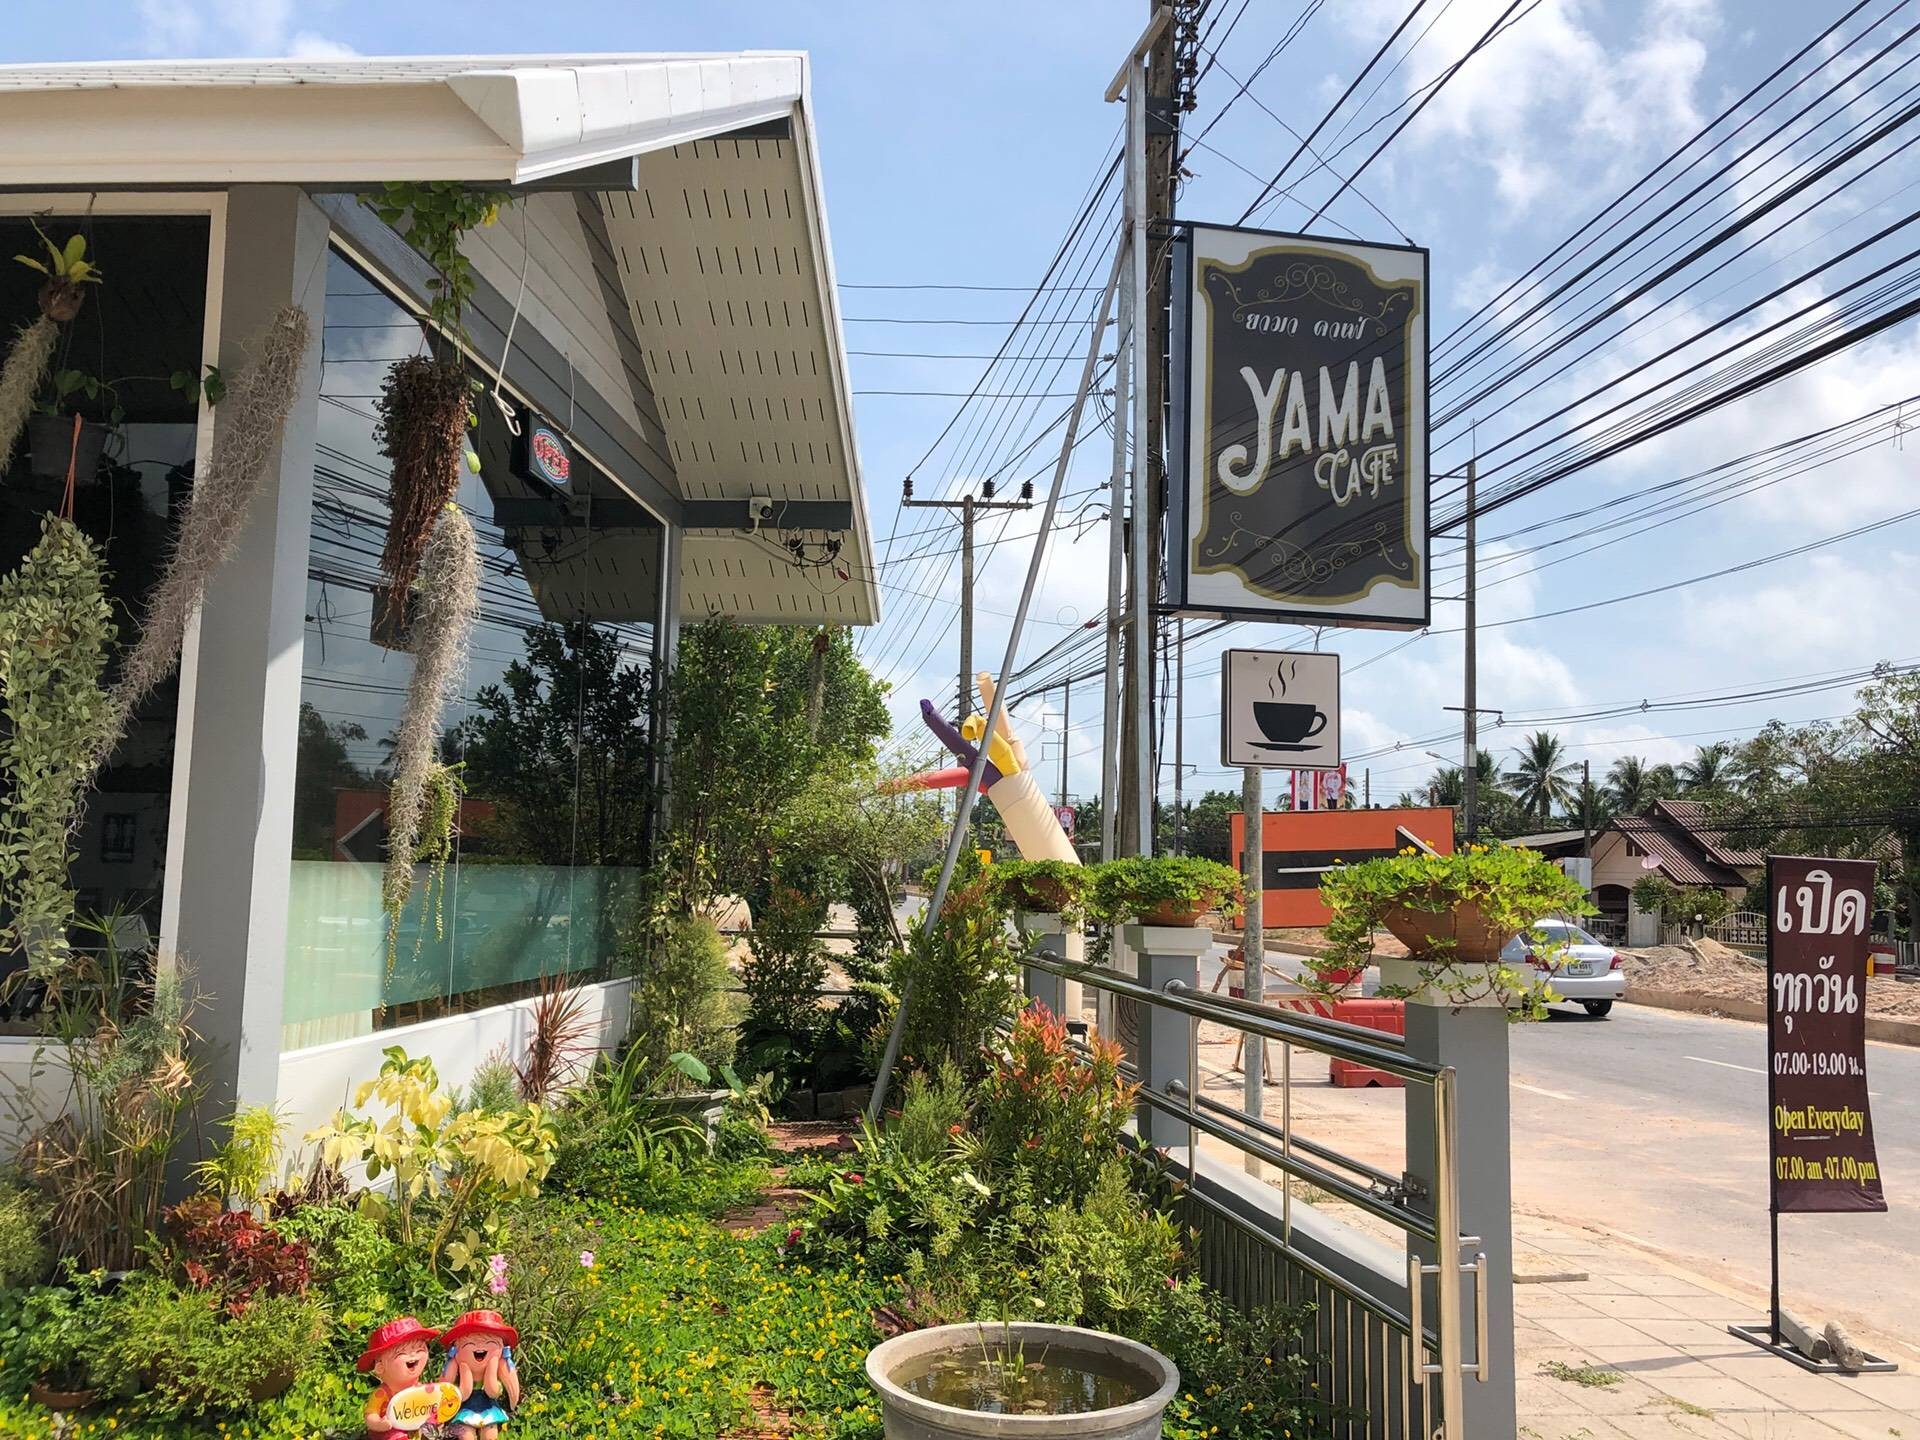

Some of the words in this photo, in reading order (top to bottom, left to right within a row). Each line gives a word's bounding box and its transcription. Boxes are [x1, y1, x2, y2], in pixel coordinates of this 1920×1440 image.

[1246, 313, 1298, 337] ยามา
[1314, 316, 1369, 340] คาเฟ่
[1217, 356, 1394, 496] YAMA
[533, 432, 570, 477] OPEN
[1776, 869, 1867, 936] เปิด
[1773, 955, 1858, 1035] ทุกวัน
[1774, 1052, 1846, 1075] 07.00-19.00
[1848, 1056, 1864, 1075] น.
[1775, 1105, 1806, 1136] Open
[1807, 1105, 1864, 1136] Everyday
[1776, 1156, 1805, 1180] 07.00
[1806, 1161, 1823, 1180] am
[1857, 1161, 1877, 1187] pm
[392, 1400, 438, 1420] Welcome
